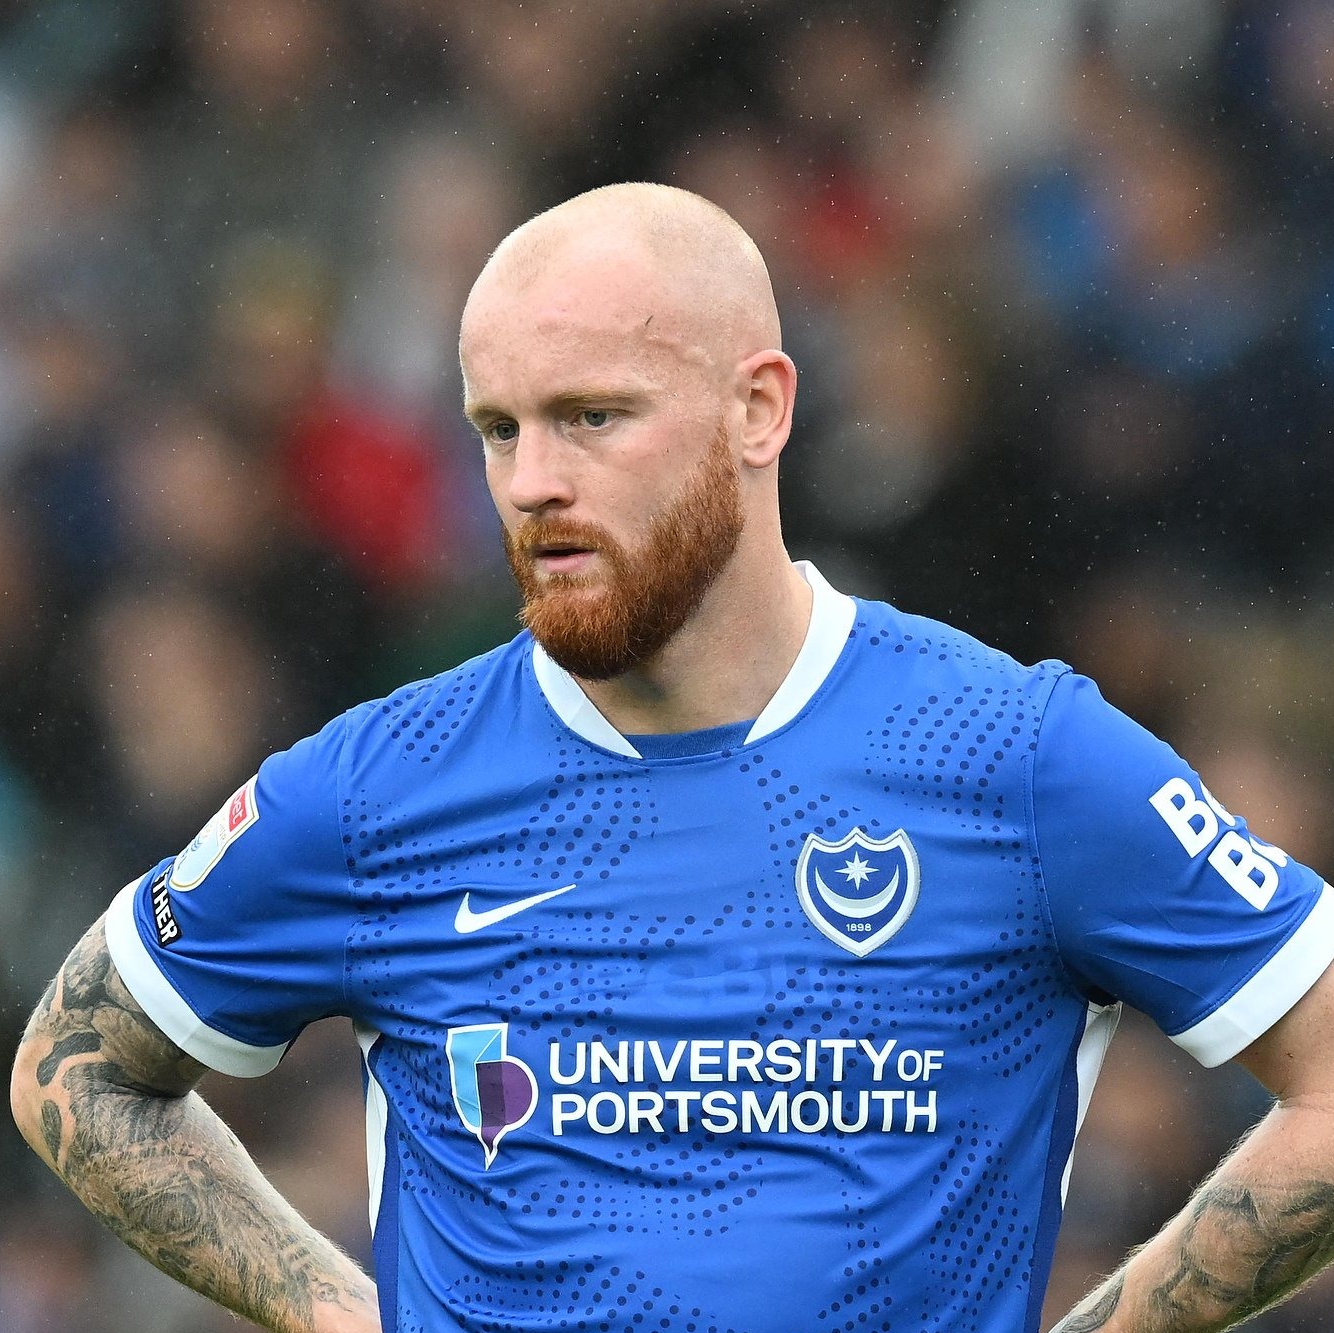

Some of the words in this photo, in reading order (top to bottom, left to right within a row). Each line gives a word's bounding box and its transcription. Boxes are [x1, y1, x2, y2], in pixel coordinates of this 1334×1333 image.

[152, 865, 178, 943] THER
[846, 923, 872, 933] 1898
[548, 1038, 898, 1085] UNIVERSITY
[896, 1049, 945, 1082] OF
[550, 1089, 939, 1137] PORTSMOUTH
